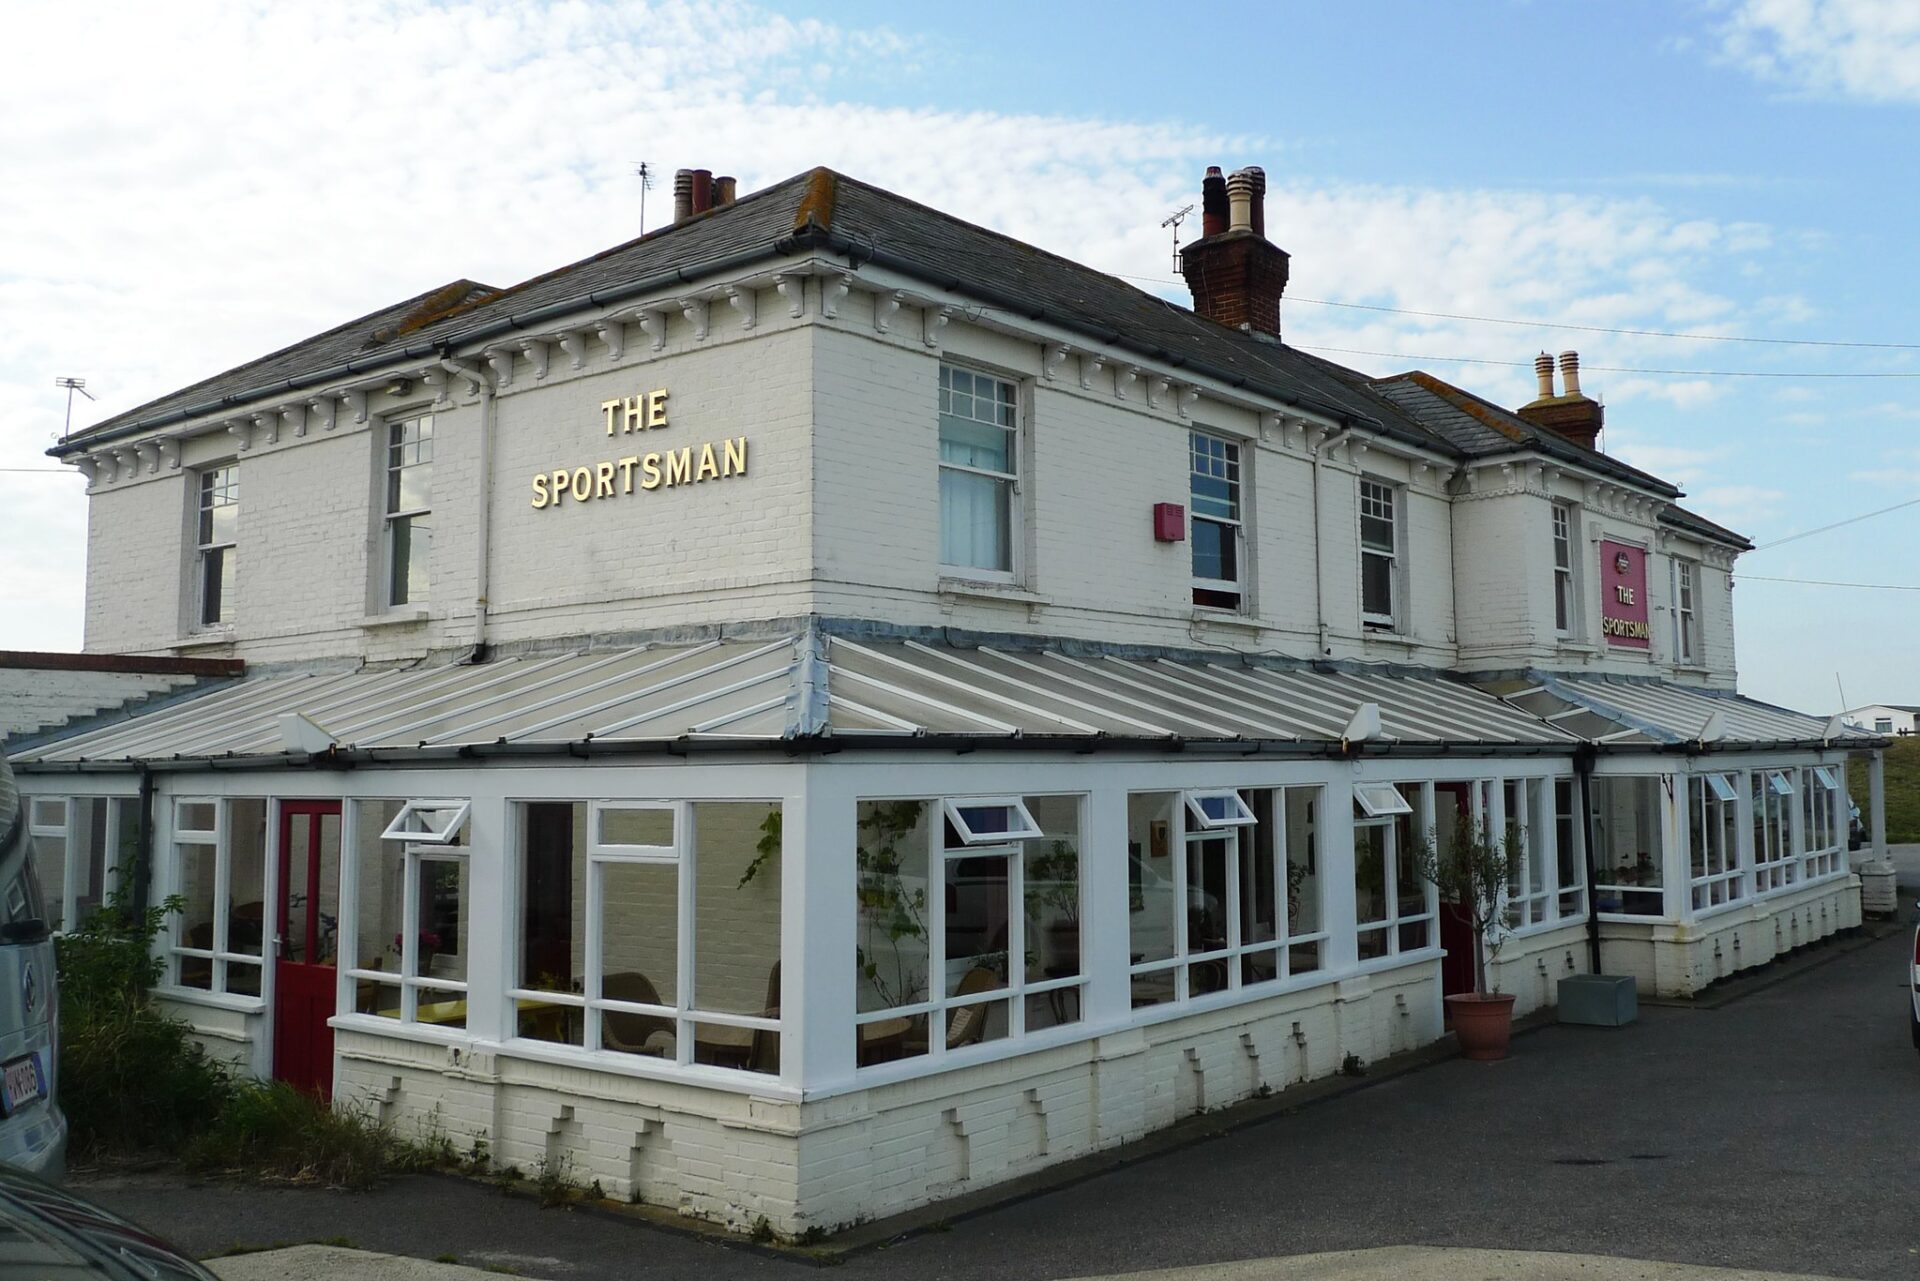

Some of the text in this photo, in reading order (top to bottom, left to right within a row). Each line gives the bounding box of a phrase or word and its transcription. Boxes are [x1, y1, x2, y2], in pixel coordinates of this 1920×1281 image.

[602, 388, 669, 436] THE
[531, 436, 747, 509] SPORTSMAN
[1617, 585, 1635, 605] THE
